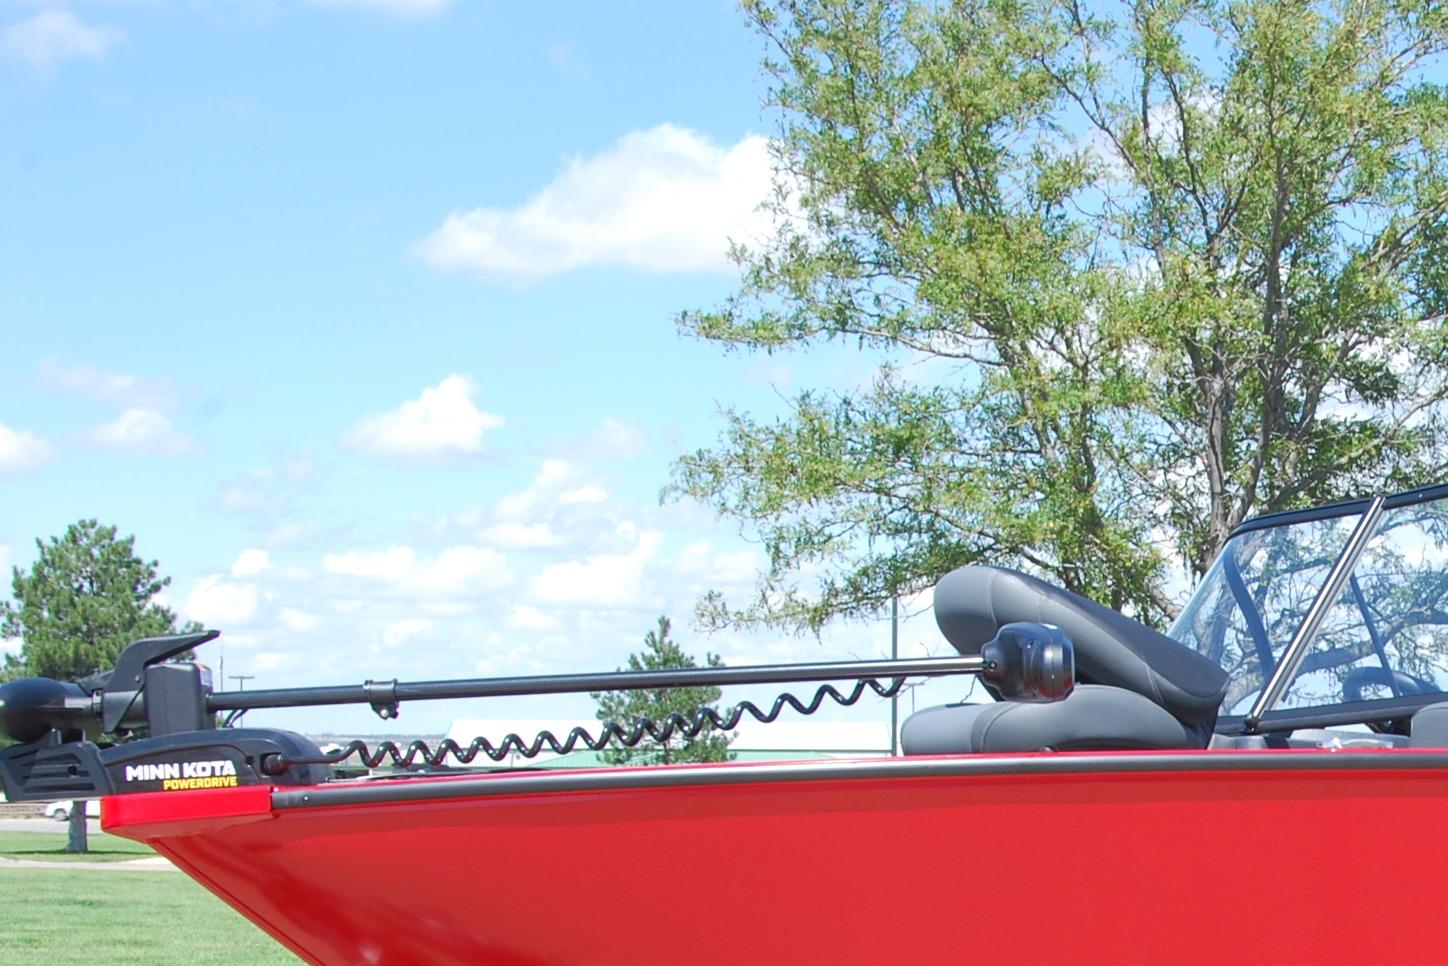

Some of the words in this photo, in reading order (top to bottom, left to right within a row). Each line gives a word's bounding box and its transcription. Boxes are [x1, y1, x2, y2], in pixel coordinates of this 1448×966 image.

[125, 763, 180, 781] MINN
[182, 760, 237, 778] KOTA
[163, 776, 238, 790] POWERDRIVE
